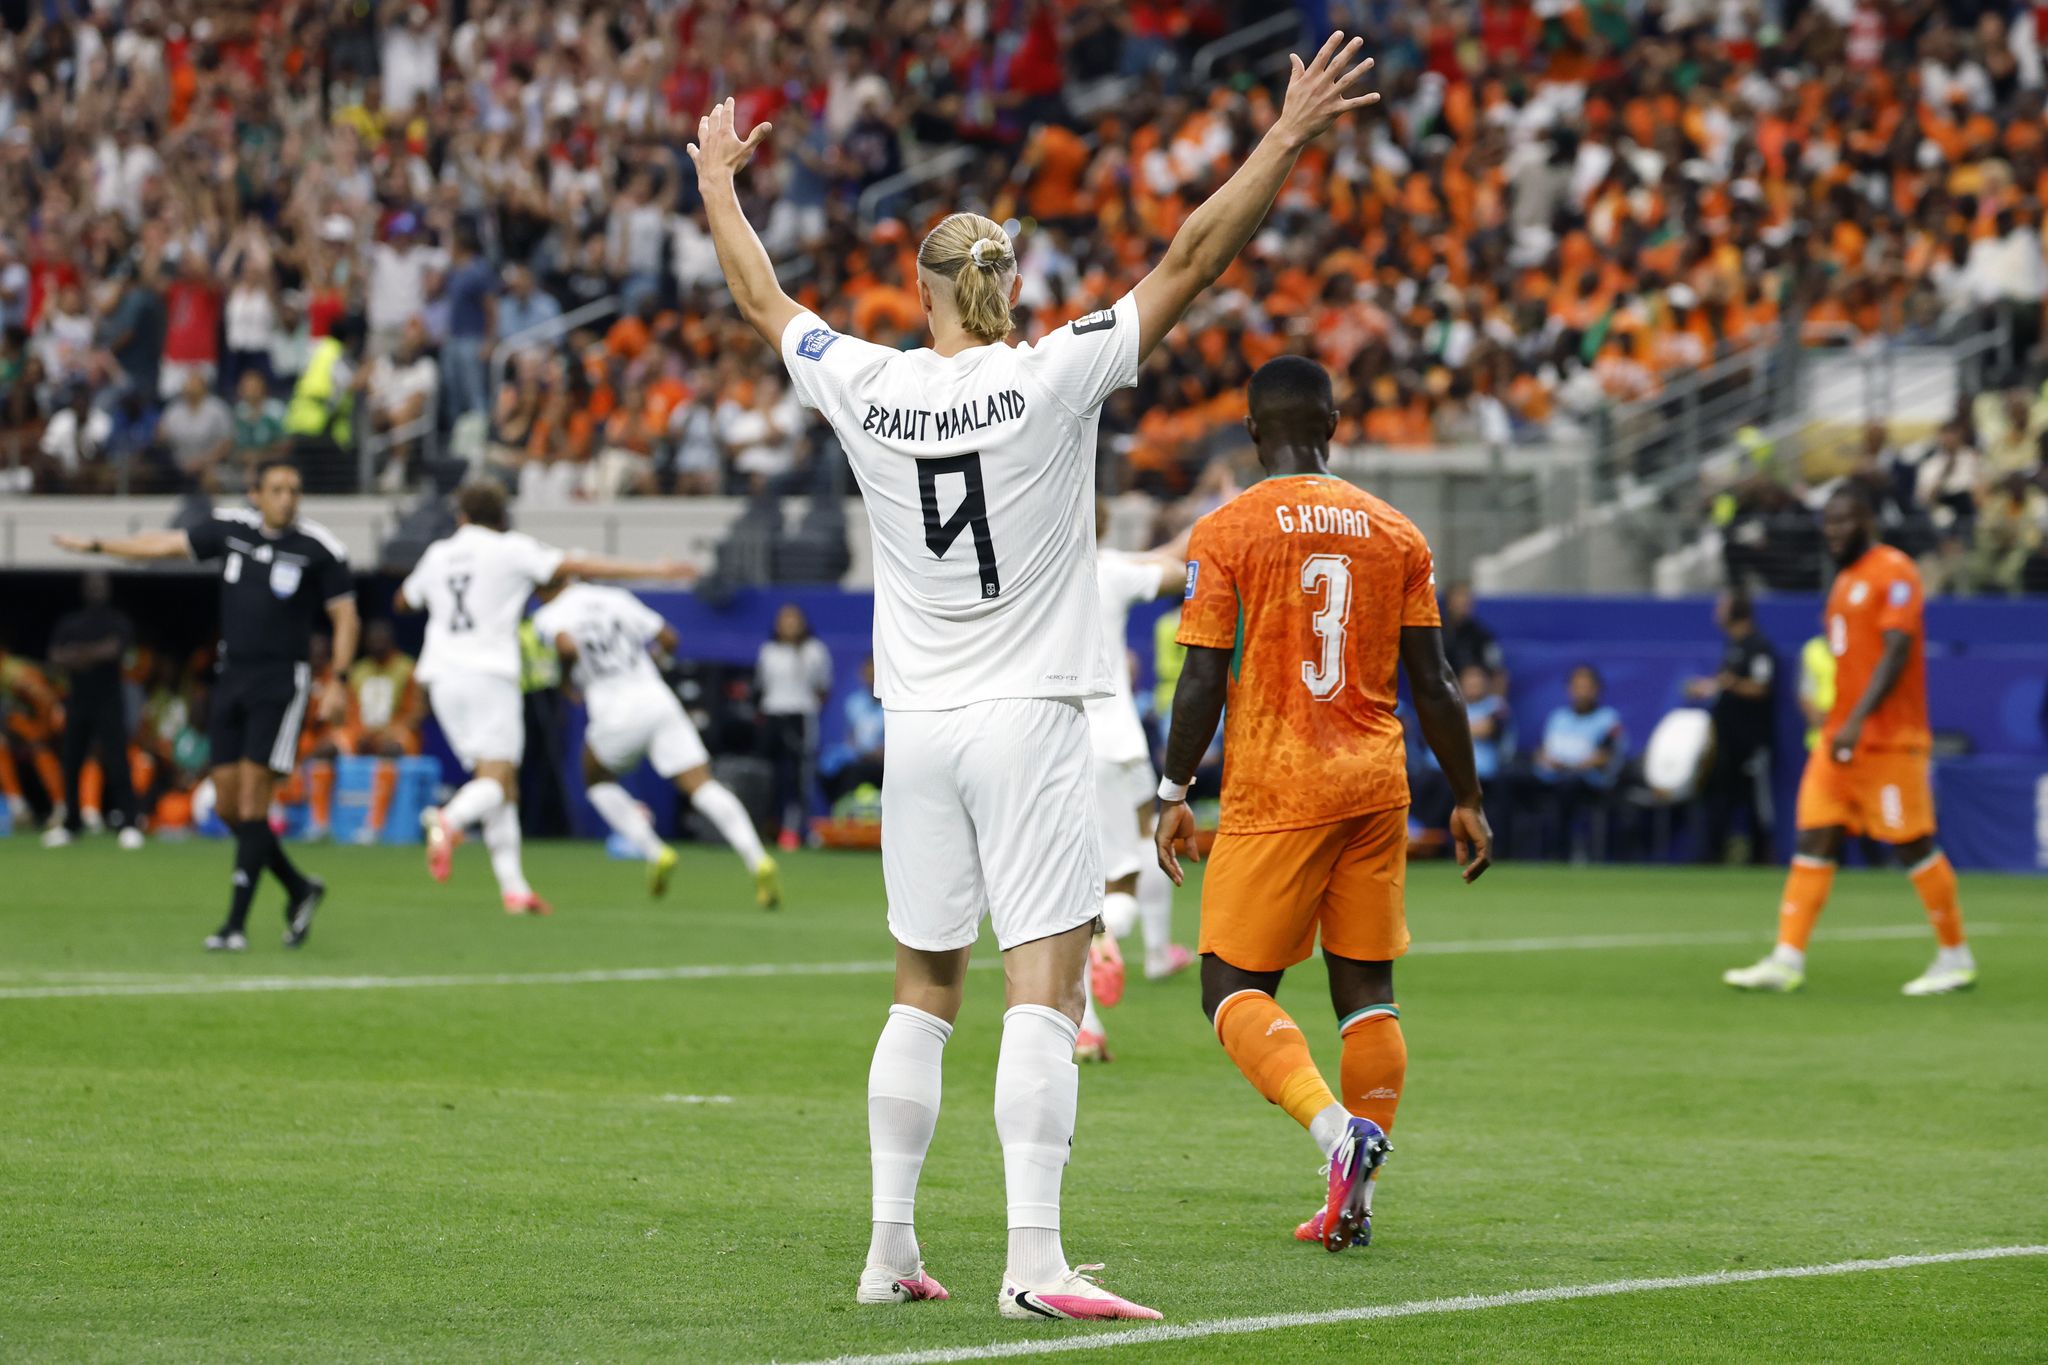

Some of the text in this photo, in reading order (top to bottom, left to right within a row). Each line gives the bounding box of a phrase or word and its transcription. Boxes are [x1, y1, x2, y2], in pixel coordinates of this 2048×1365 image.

[863, 389, 1026, 441] BRAUT HAALAND
[915, 451, 1000, 599] 9
[1300, 553, 1353, 702] 3
